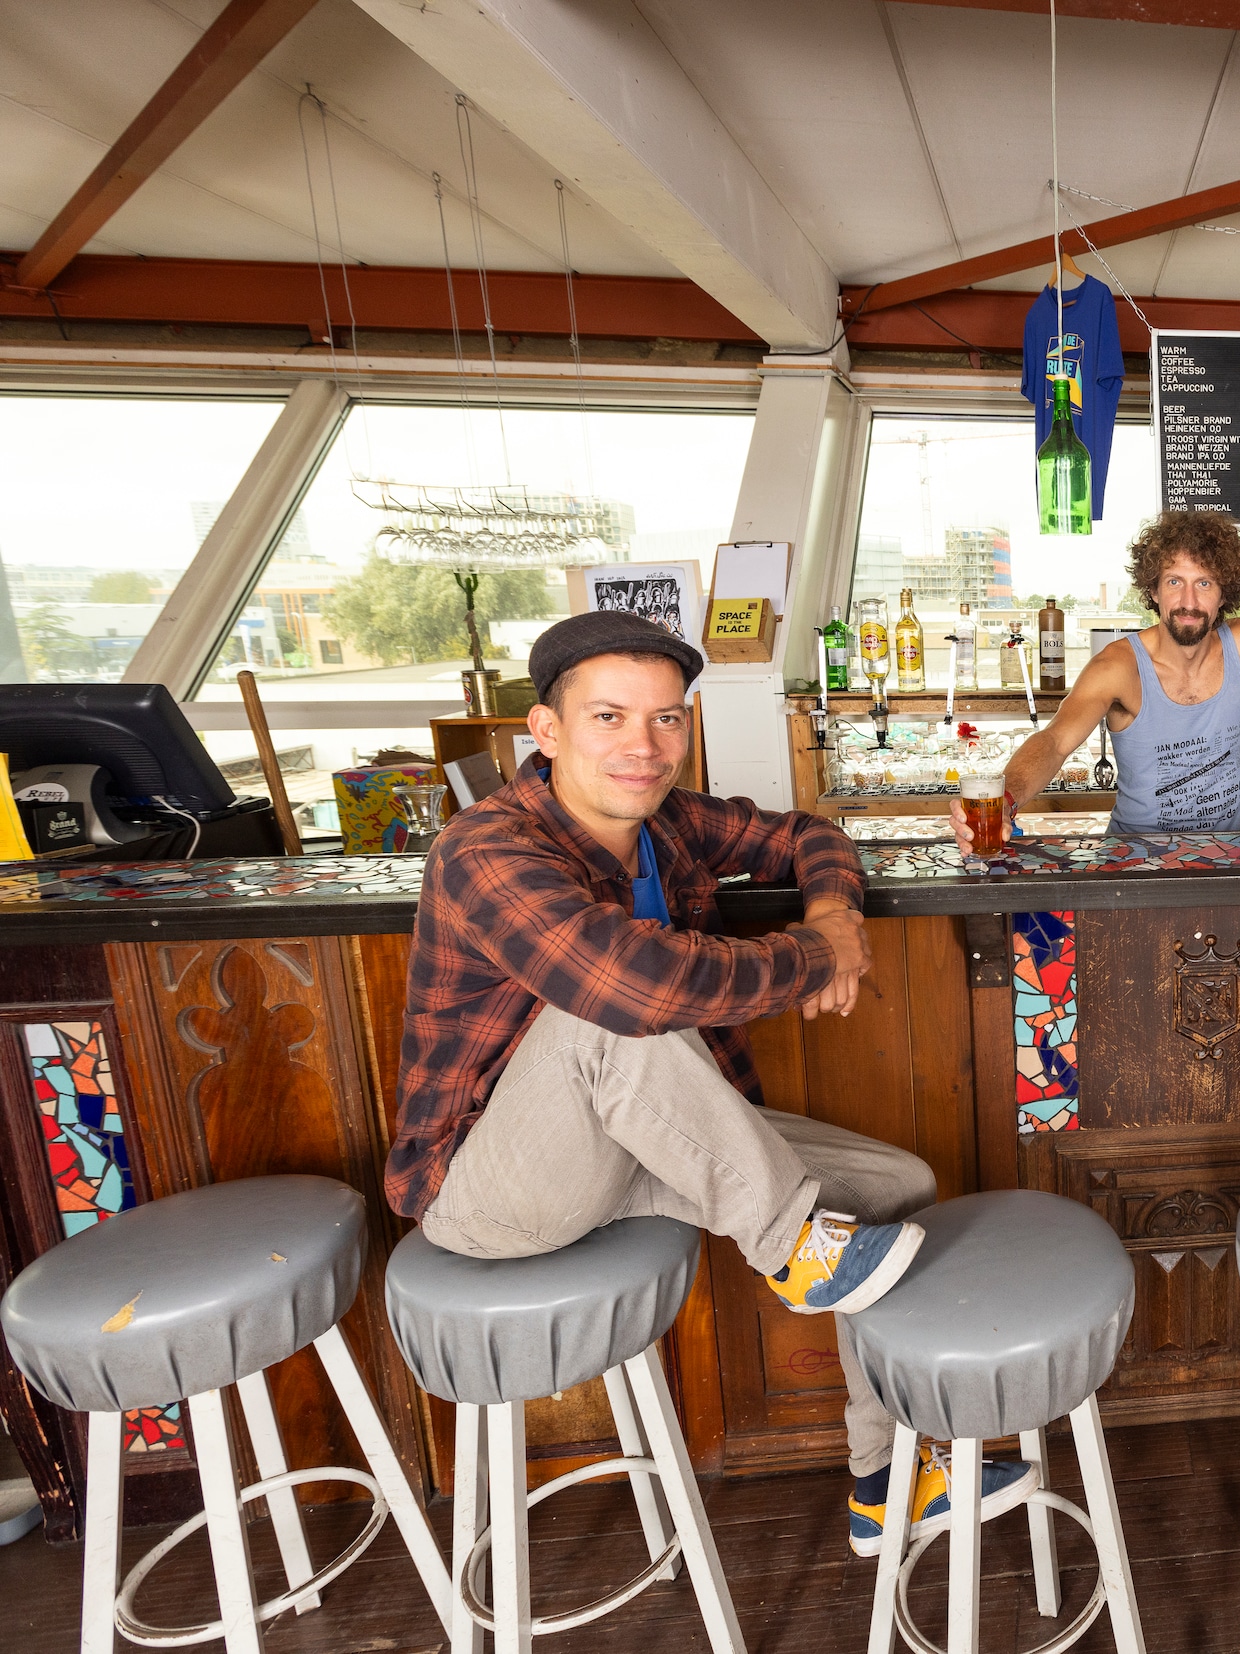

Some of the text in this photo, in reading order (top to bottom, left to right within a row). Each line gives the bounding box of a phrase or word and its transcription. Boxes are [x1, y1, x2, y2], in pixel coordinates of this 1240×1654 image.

[1067, 336, 1075, 346] DE
[1161, 358, 1195, 366] COFFEE
[1162, 367, 1206, 375] ESPRESSO
[1161, 375, 1178, 383] TEA
[1162, 384, 1214, 392] CAPPUCCINO
[1164, 416, 1200, 424] PILSNER
[1203, 416, 1231, 424] BRAND
[1167, 435, 1198, 443] TROOST
[1201, 435, 1228, 443] VIRGIN
[1166, 444, 1194, 452] BRAND
[1197, 444, 1230, 452] WEIZEN
[1166, 452, 1194, 460] BRAND
[1197, 452, 1210, 460] IPA
[1168, 471, 1186, 479] THAI
[1192, 471, 1211, 479] THAI
[1167, 479, 1218, 487] POLYAMORIE
[1168, 487, 1221, 495] HOPPENBIER
[1169, 496, 1186, 504] GAIA
[1170, 504, 1188, 512] PAIS
[1194, 504, 1232, 512] TROPICAL
[719, 612, 752, 620] SPACE
[716, 625, 751, 633] PLACE
[1044, 640, 1064, 648] BOLS
[1173, 736, 1207, 750] MODAAL:
[1157, 746, 1210, 761] wakker worden
[1196, 781, 1240, 805] Geen reëel
[50, 817, 77, 830] Brand
